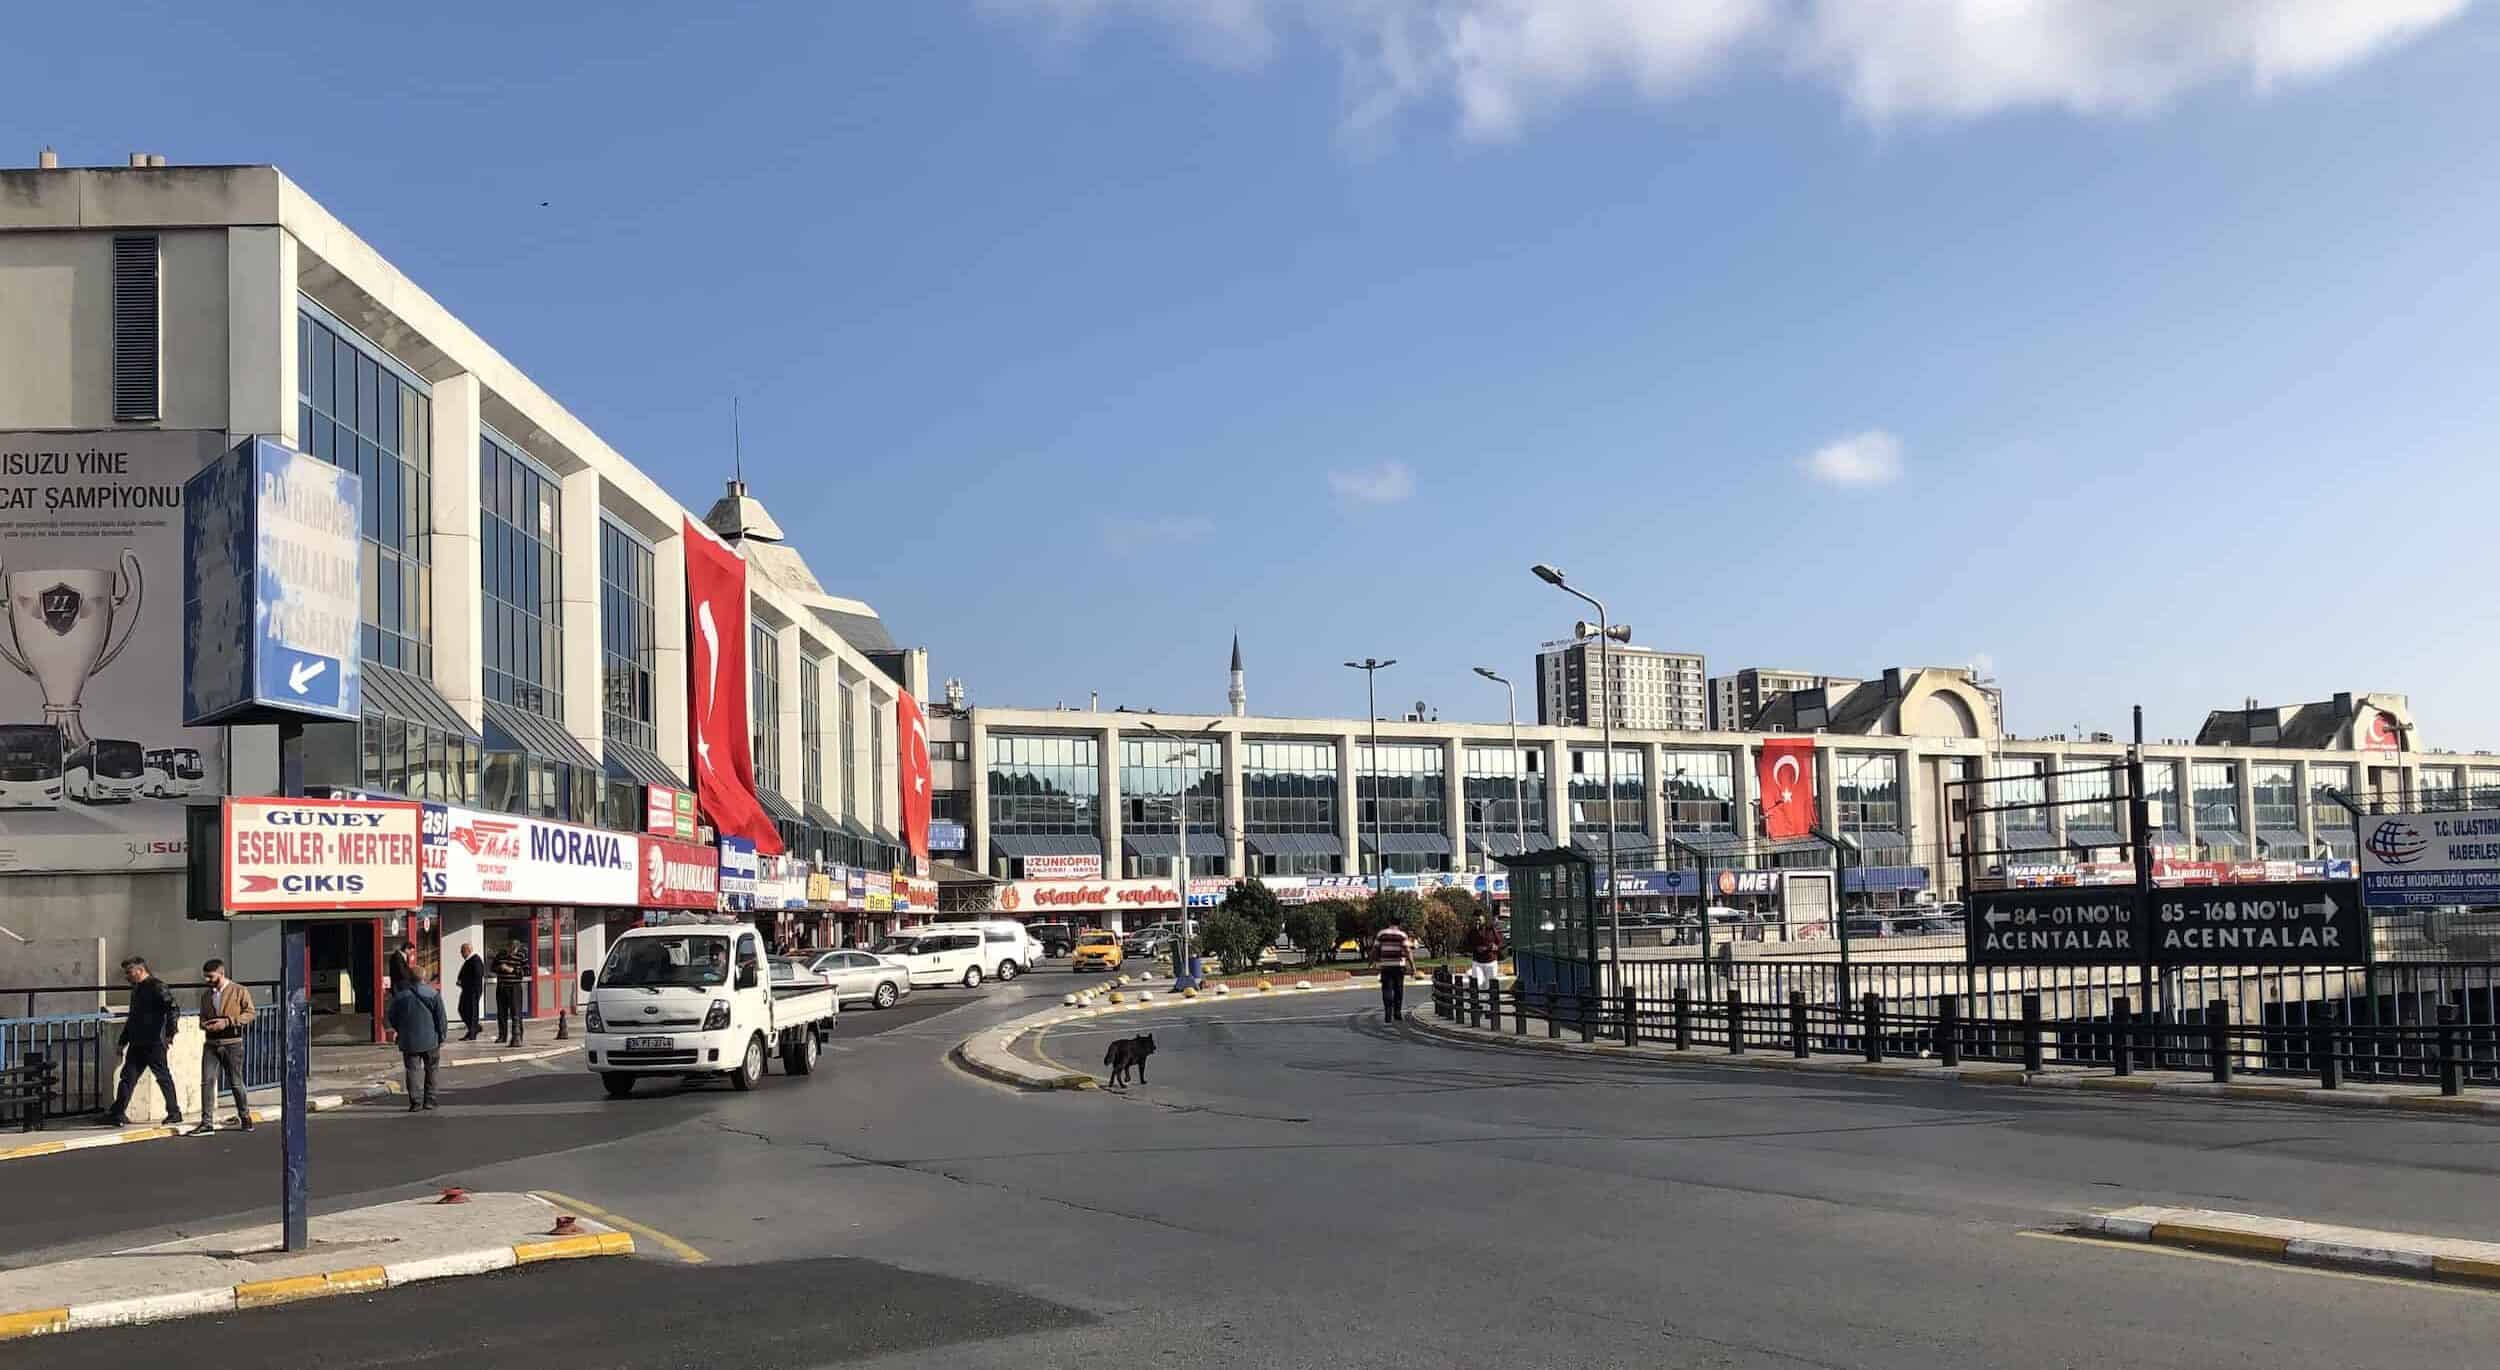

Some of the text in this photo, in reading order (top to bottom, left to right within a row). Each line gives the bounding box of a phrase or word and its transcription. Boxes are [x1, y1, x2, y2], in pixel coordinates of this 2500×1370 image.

[2, 448, 129, 475] ISUZU YİNE
[45, 482, 180, 514] ŞAMPİYONU
[266, 808, 385, 827] GÜNEY
[238, 832, 413, 865] ESENLER MERTER
[530, 824, 622, 870] MORAVA
[282, 875, 364, 895] ÇIKIŞ
[1985, 929, 2130, 951] ACENTALAR
[2163, 926, 2341, 949] ACENTALAR
